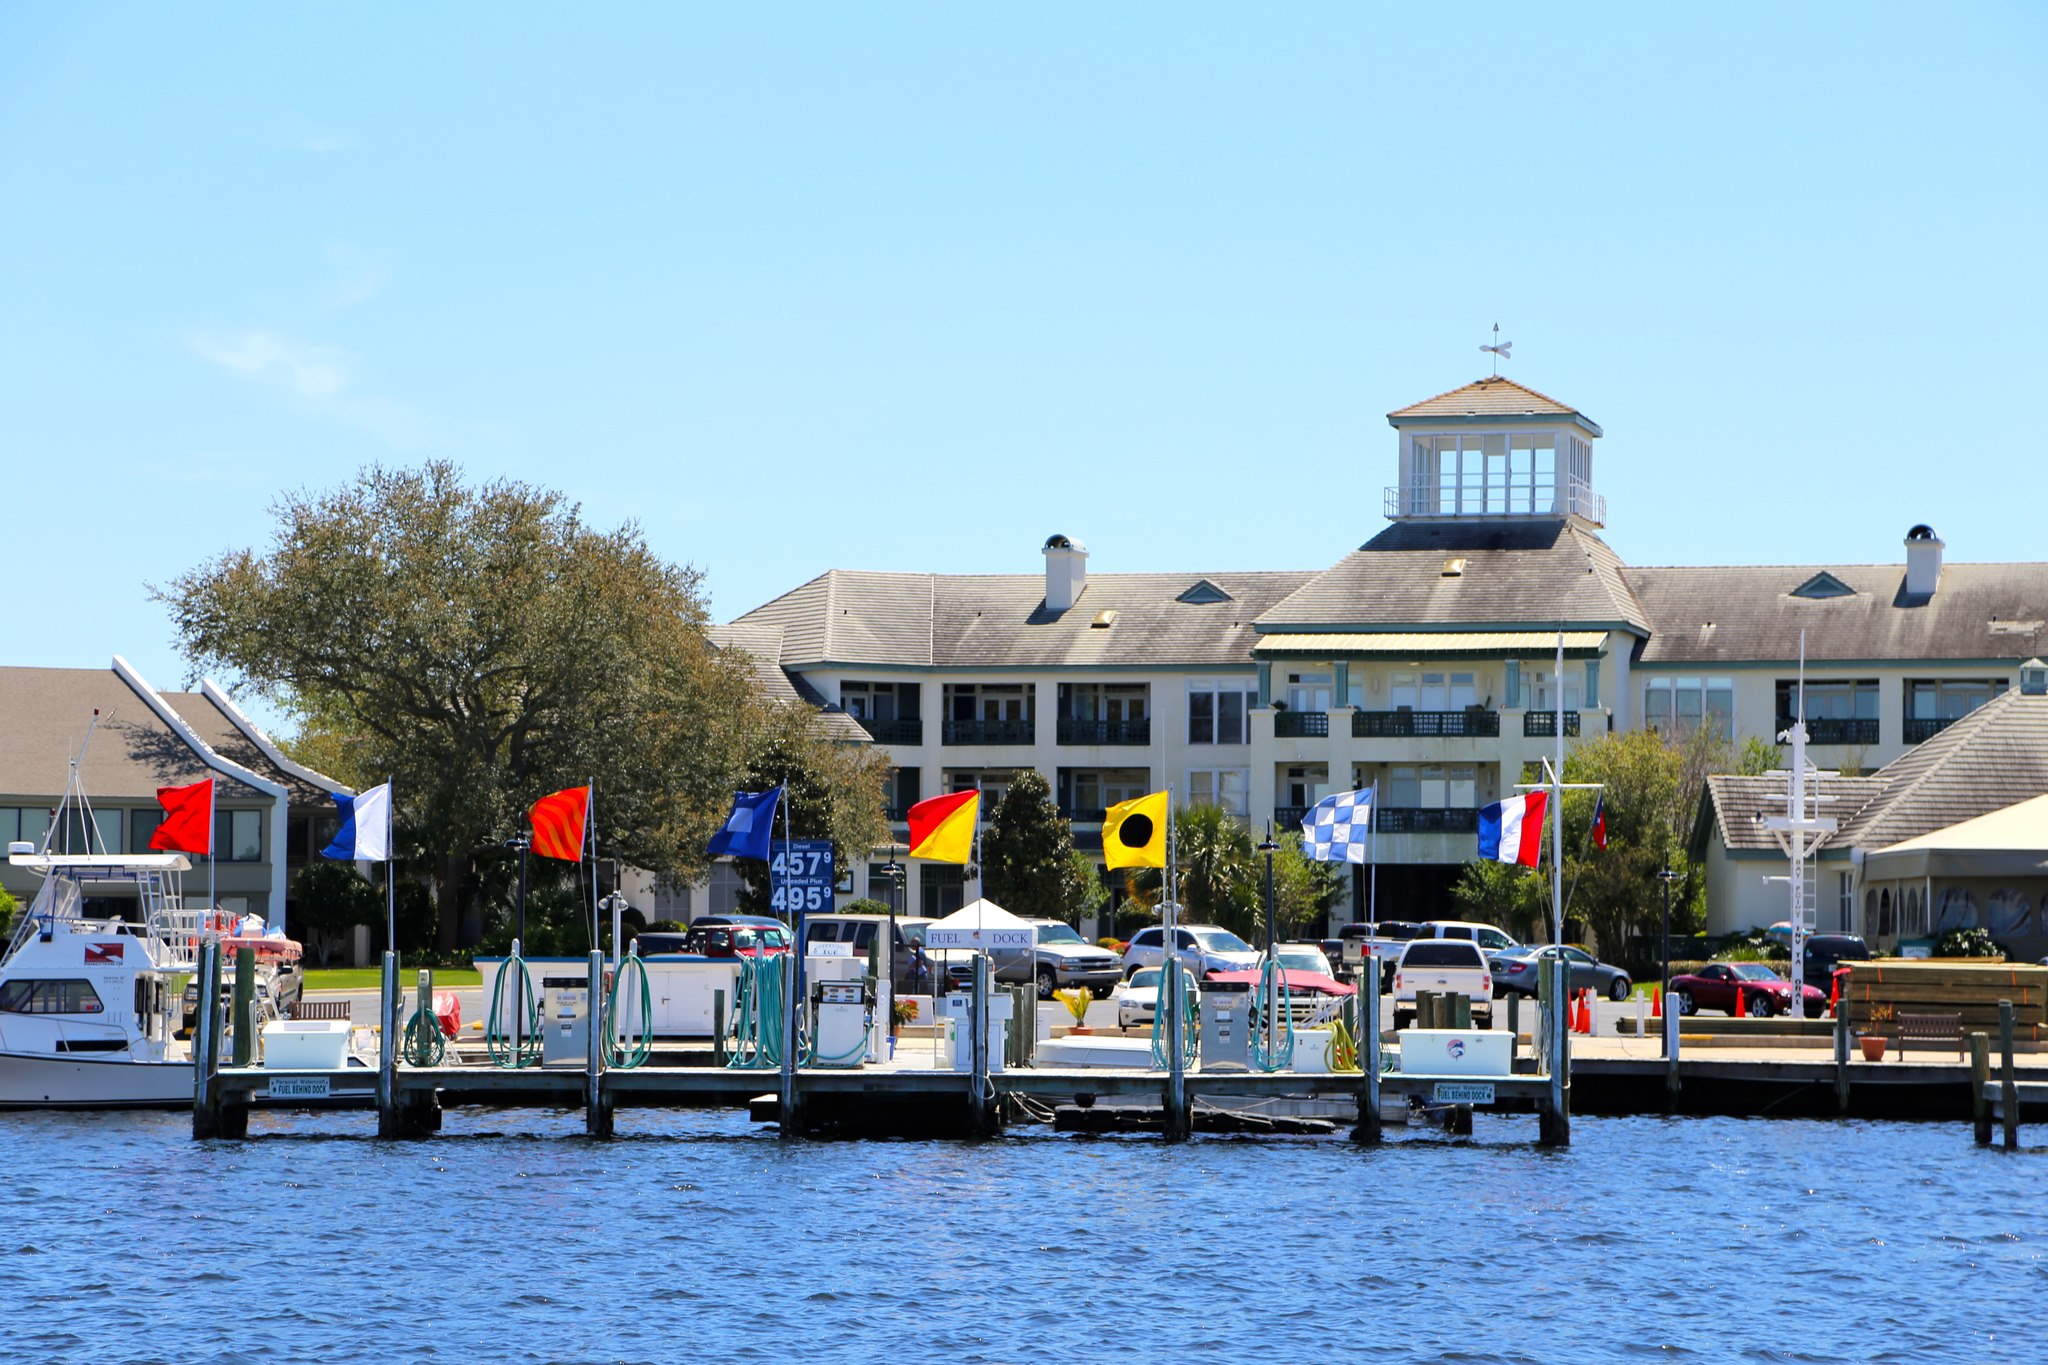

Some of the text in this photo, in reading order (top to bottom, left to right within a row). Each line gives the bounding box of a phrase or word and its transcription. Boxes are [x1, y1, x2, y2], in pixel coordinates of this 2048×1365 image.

[931, 933, 1028, 944] FUEL DOCK
[278, 1085, 327, 1095] FUEL BEHIND DOCK
[1437, 1090, 1486, 1100] FUEL BEHIND DOCK
